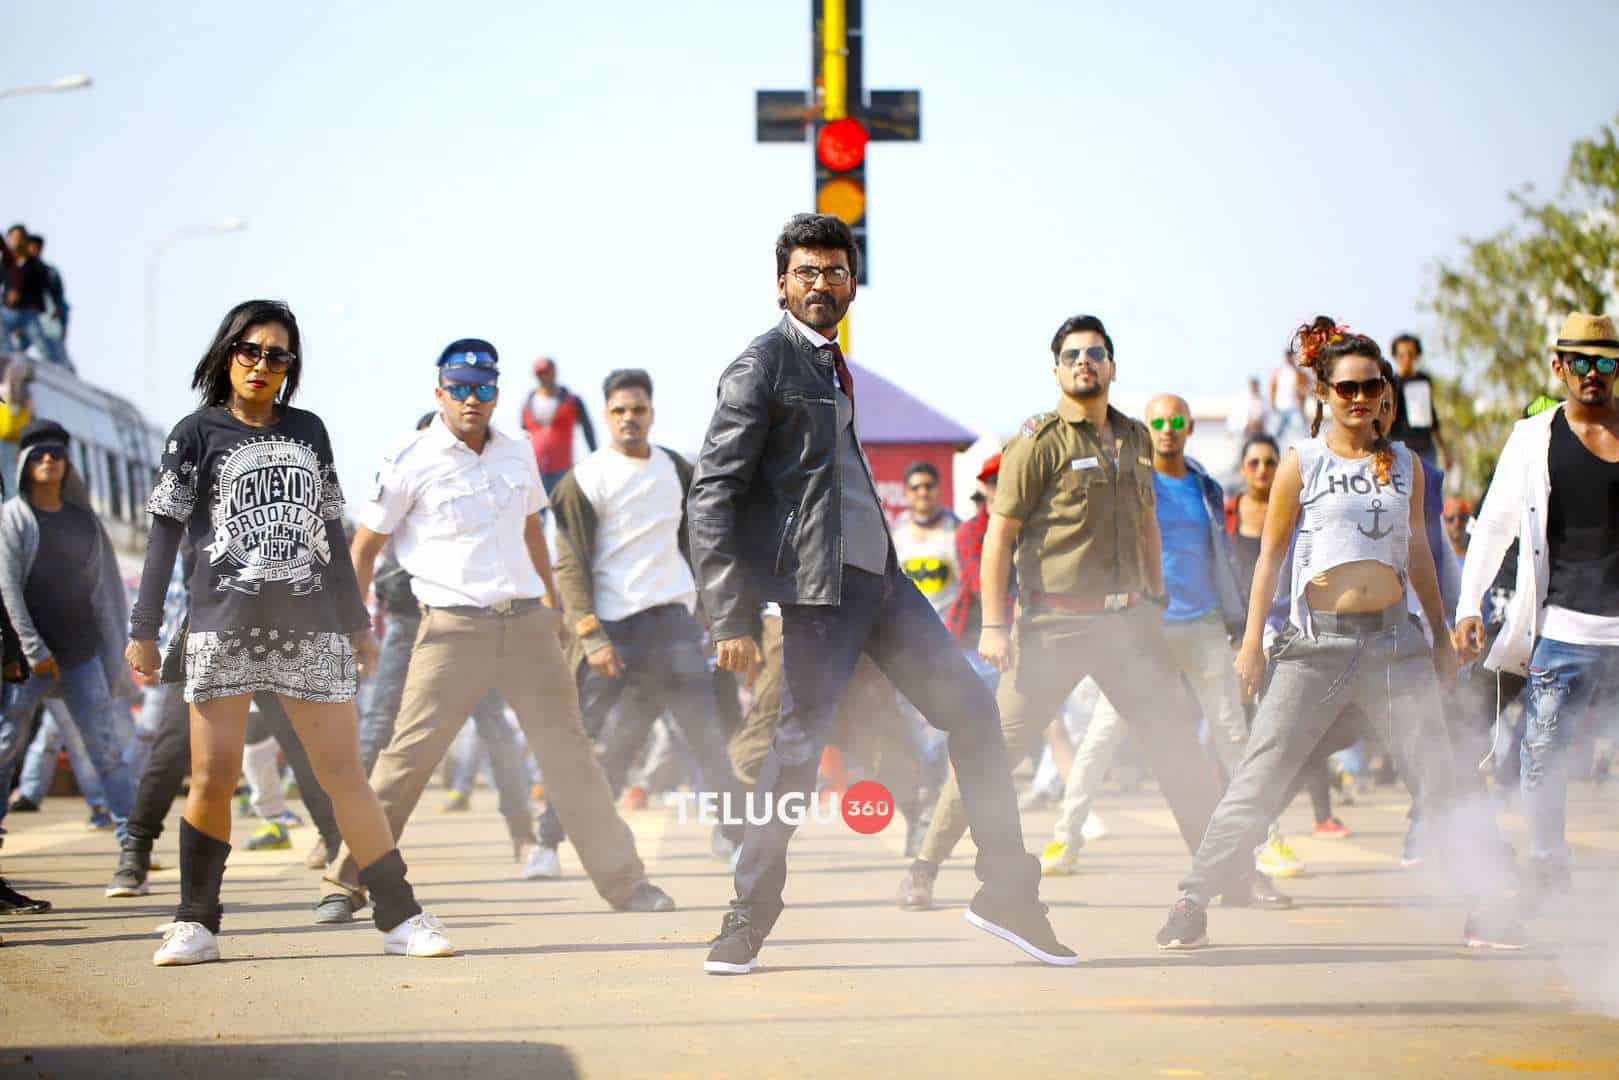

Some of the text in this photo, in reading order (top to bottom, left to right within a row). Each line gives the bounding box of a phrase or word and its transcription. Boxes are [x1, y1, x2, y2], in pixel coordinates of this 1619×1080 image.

[230, 467, 274, 514] NEW
[278, 467, 319, 514] YOR
[1328, 474, 1407, 495] HOPE
[225, 504, 324, 540] BROOKLN
